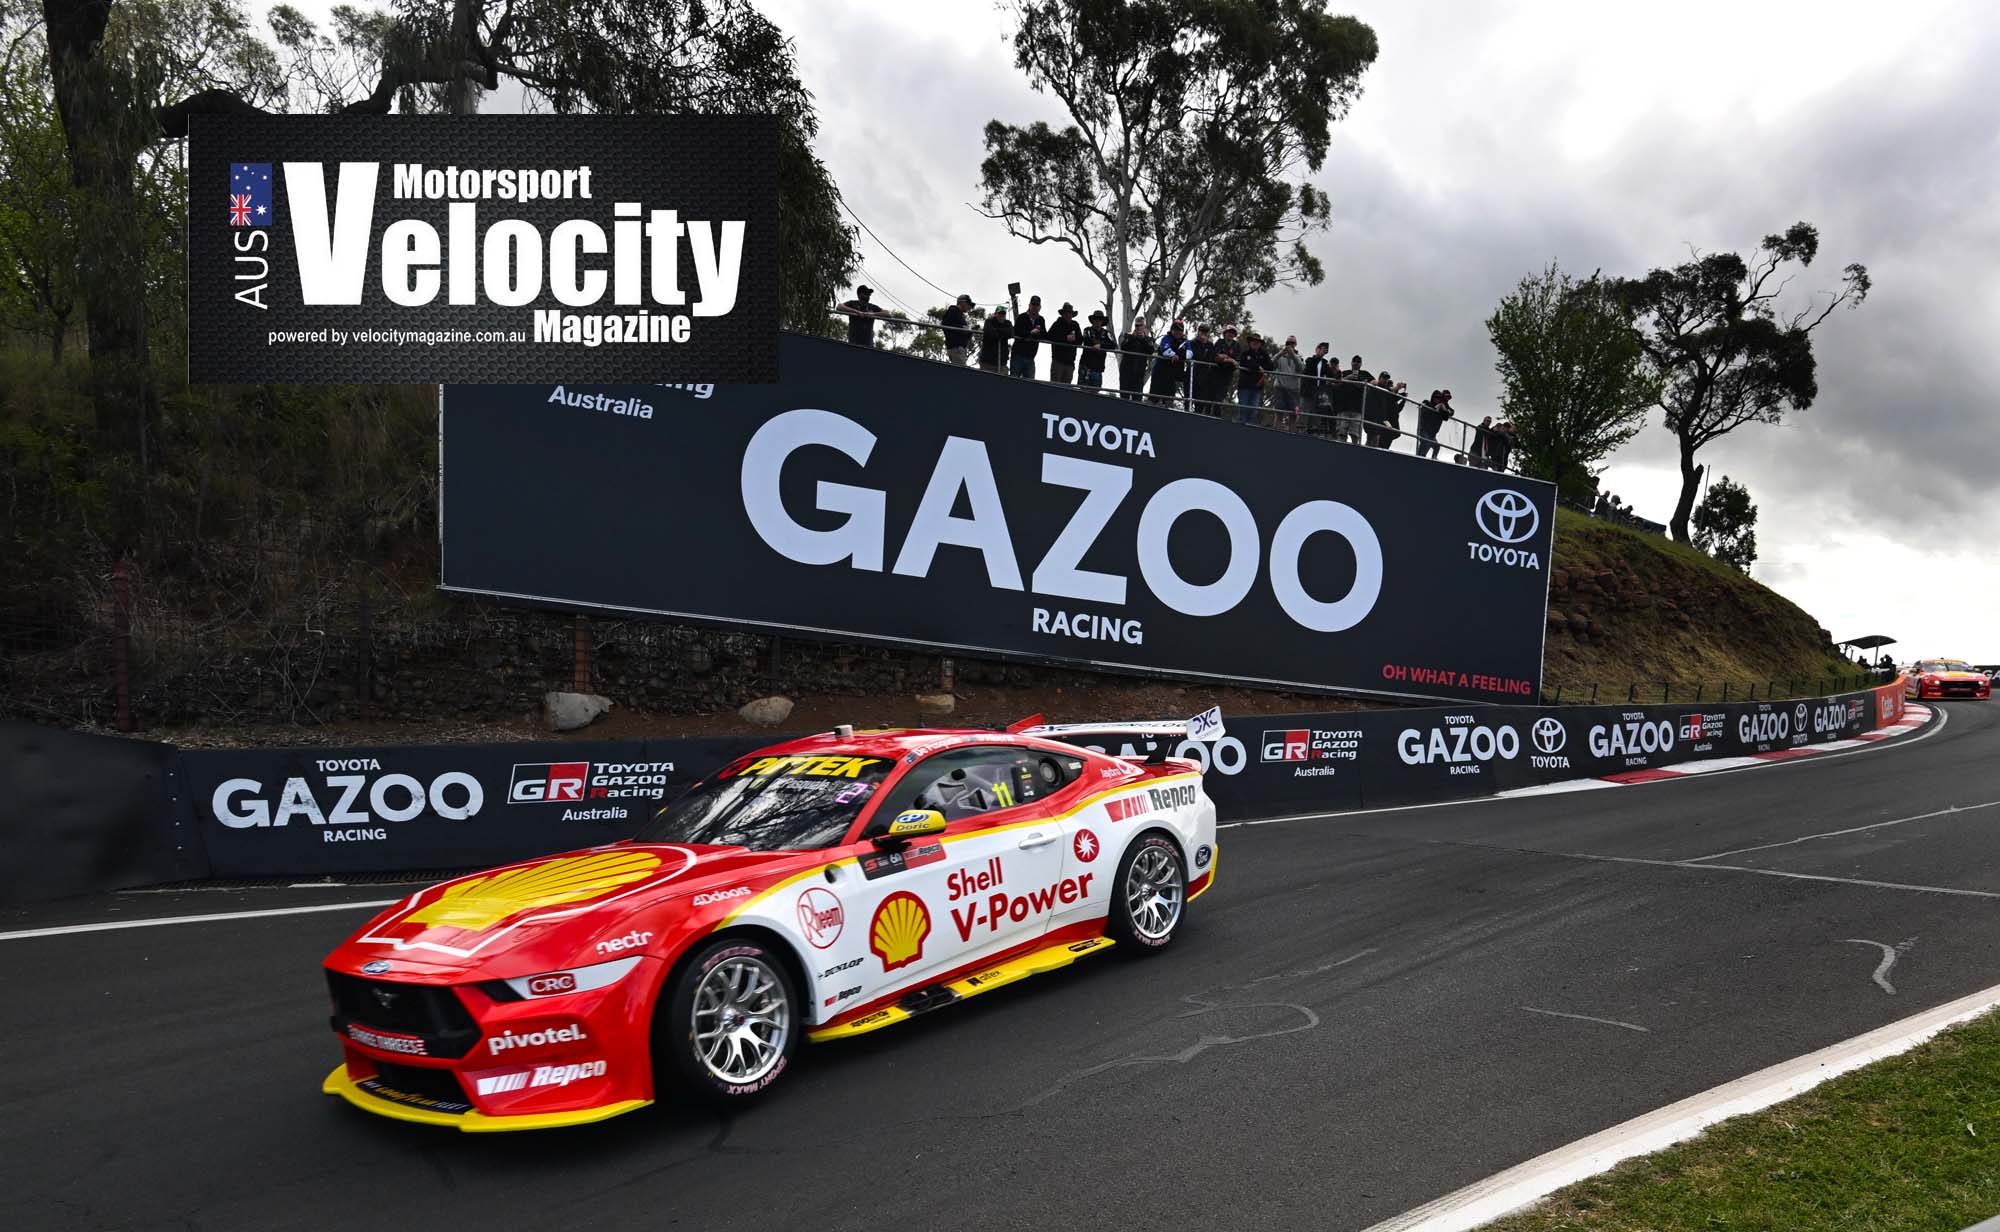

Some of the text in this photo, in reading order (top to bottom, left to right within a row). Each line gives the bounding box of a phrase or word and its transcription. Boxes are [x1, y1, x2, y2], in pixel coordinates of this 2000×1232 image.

[548, 384, 654, 419] Australia
[1042, 412, 1157, 459] TOYOTA
[740, 408, 1384, 633] GAZOO
[1468, 541, 1541, 571] TOYOTA
[1032, 607, 1144, 646] RACING
[1382, 664, 1532, 696] OH WHAT A FEELING
[1444, 714, 1475, 726] TOYOTA
[1738, 711, 1789, 744] GAZOO
[1813, 703, 1847, 733] GAZOO
[1312, 729, 1364, 741] TOYOTA
[1588, 719, 1675, 760] GAZOO
[1680, 724, 1701, 740] GR
[1263, 742, 1307, 760] GR
[1310, 749, 1358, 761] Racing
[1311, 740, 1359, 750] GAZOO
[1397, 724, 1520, 766] GAZOO
[316, 757, 382, 773] TOYOTA
[593, 761, 675, 775] TOYOTA
[1294, 765, 1336, 777] Australia
[1449, 763, 1481, 776] RACING
[1530, 755, 1571, 770] TOYOTA
[1624, 756, 1648, 768] RACING
[512, 777, 583, 801] GR
[591, 774, 667, 787] GAZOO
[211, 771, 485, 830] GAZOO
[590, 786, 665, 800] Racing
[991, 781, 1014, 808] 11
[1150, 783, 1197, 813] Repco
[561, 806, 629, 822] Australia
[323, 827, 388, 844] RACING
[896, 822, 930, 832] Doric
[947, 856, 1004, 902] Shell
[950, 872, 1094, 943] V-Power
[595, 930, 654, 956] nectr
[824, 957, 864, 978] DUNLOP
[529, 974, 574, 992] CRC
[487, 1023, 587, 1057] pivotel.
[528, 1060, 607, 1088] Repco
